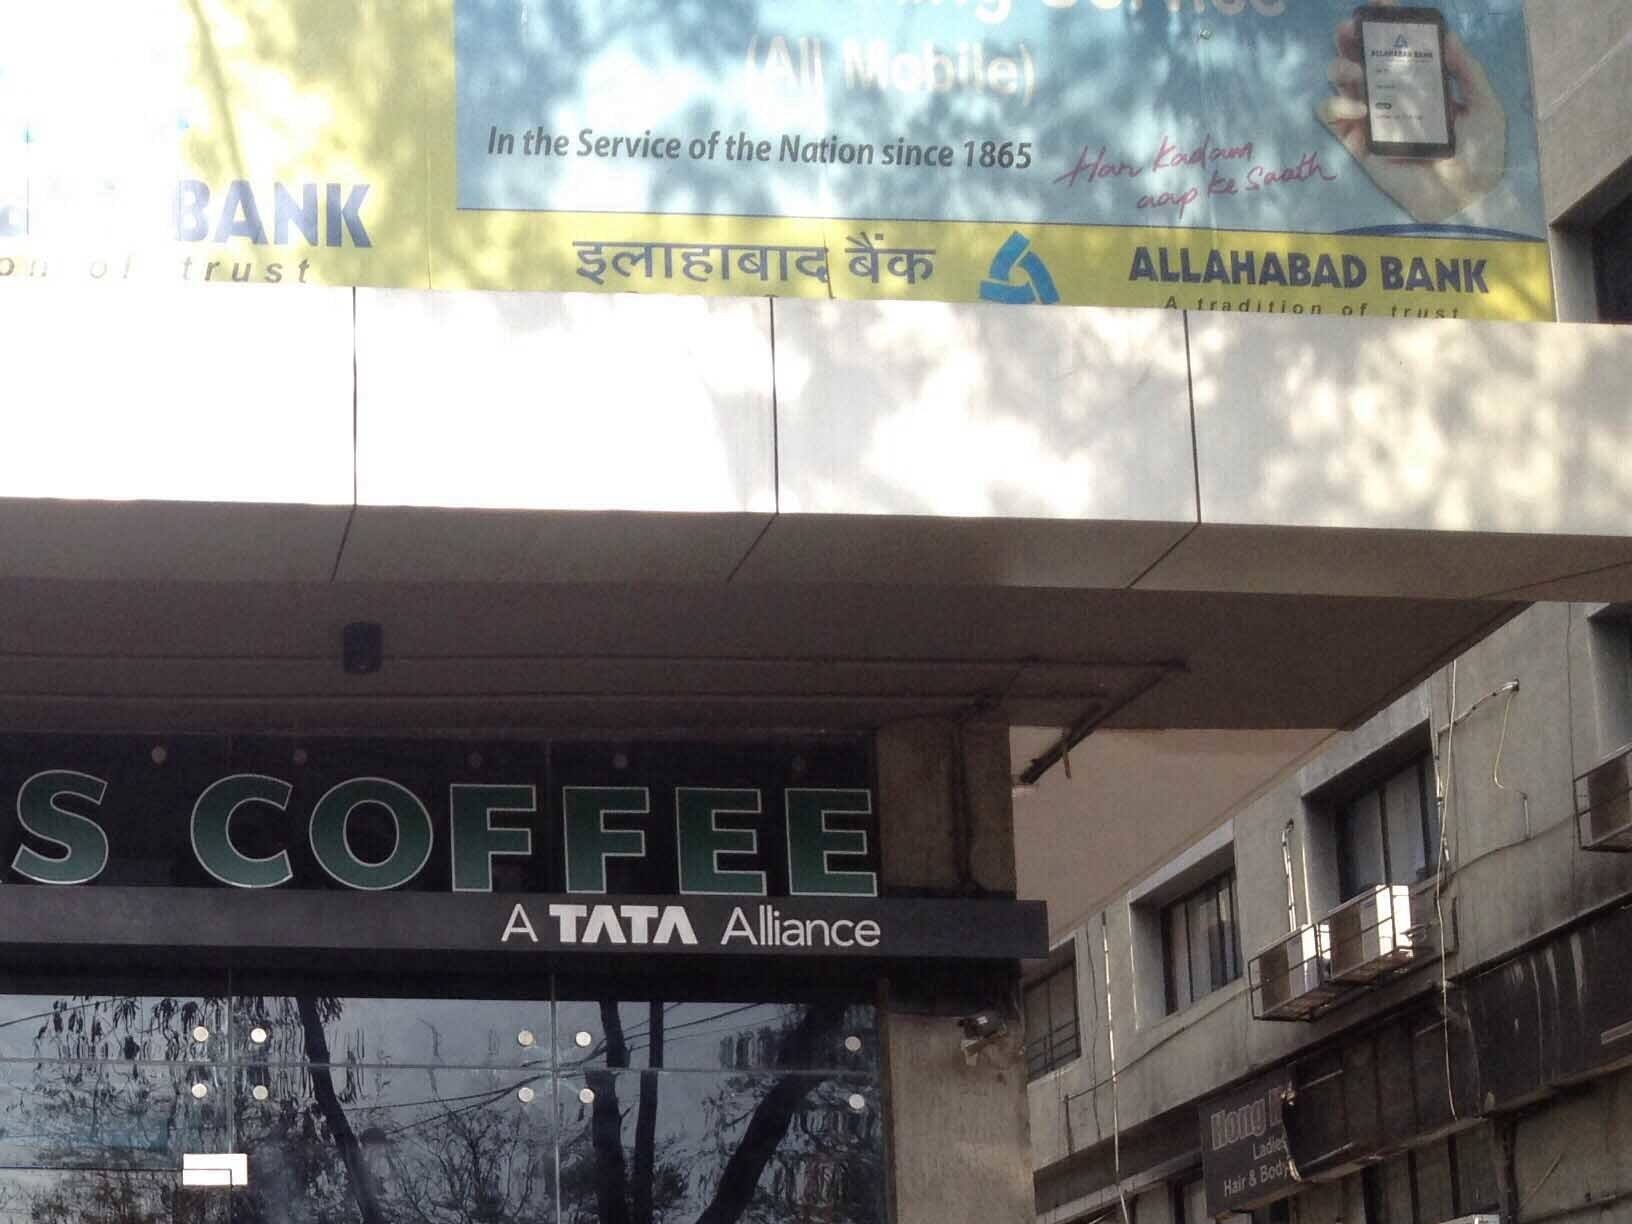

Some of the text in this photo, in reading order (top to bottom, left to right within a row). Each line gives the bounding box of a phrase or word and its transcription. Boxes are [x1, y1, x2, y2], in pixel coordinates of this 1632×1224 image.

[842, 38, 1036, 106] Mobile)
[487, 125, 1033, 169] In the Service of the Nation since 1865
[173, 180, 373, 248] BANK
[181, 257, 310, 284] trust
[572, 232, 937, 286] इलाहाबाद बैंक
[1129, 246, 1489, 294] ALLAHABAD BANK
[1165, 295, 1459, 319] A tradition of trust
[190, 773, 879, 897] COFFEE
[501, 903, 882, 949] A TATA Alliance
[1223, 1174, 1246, 1198] Hair
